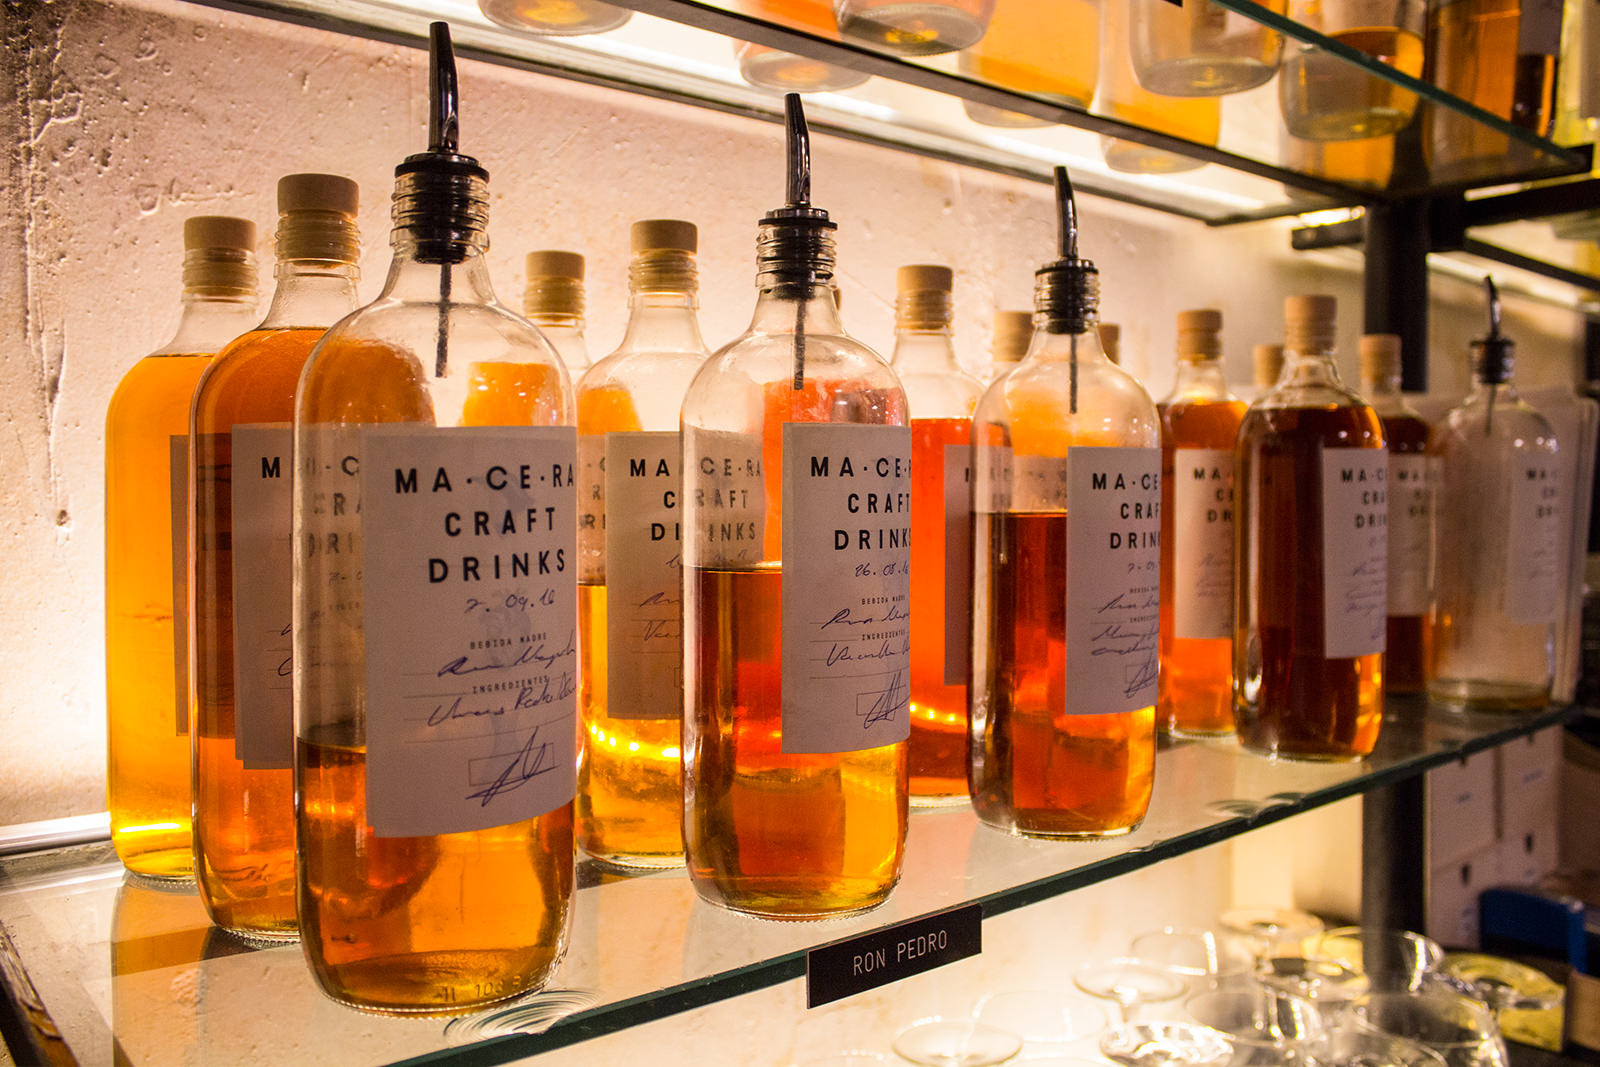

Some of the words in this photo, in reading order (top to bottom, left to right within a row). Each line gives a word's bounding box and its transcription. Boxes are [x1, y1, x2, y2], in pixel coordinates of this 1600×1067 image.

[445, 507, 555, 537] CRAFT
[429, 549, 565, 583] DRINKS
[469, 637, 512, 650] BEBIDA
[853, 948, 886, 976] RON
[897, 929, 948, 963] PEDRO
